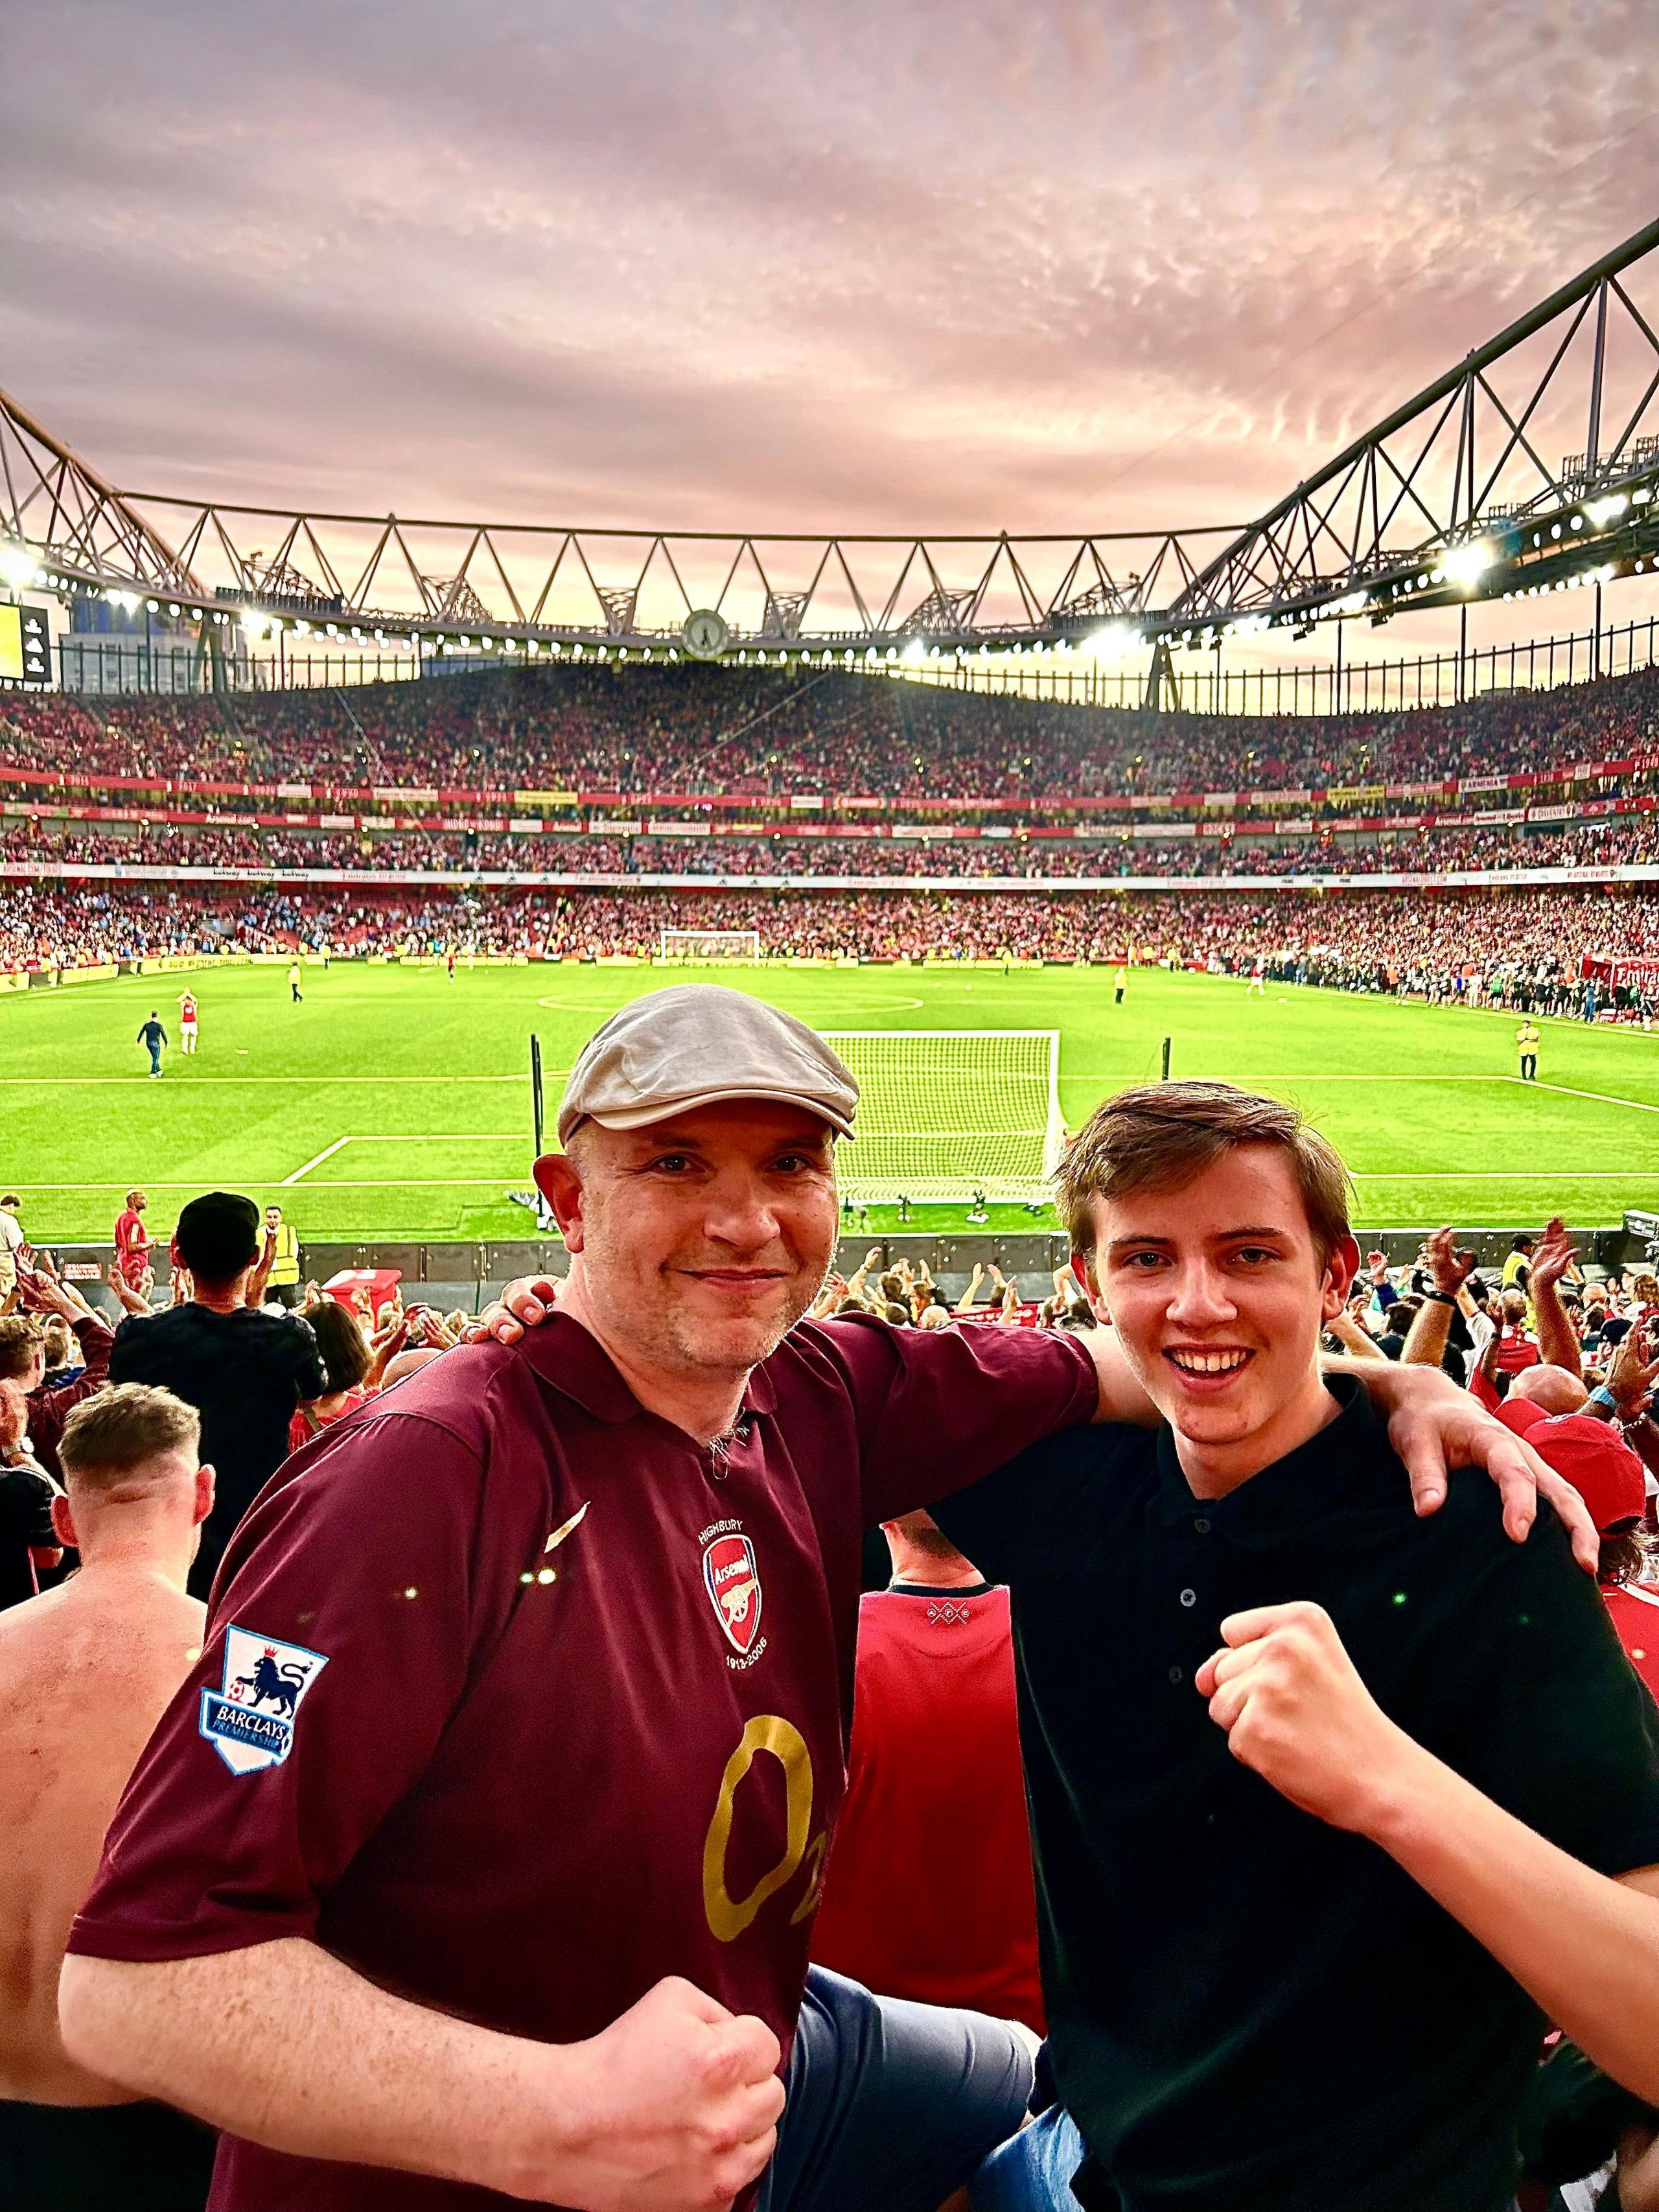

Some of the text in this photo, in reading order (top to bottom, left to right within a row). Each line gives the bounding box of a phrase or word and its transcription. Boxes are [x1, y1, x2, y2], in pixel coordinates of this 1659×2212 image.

[1468, 779, 1498, 789] ARMENIA
[698, 1519, 743, 1545] HIGHBURY
[715, 1554, 750, 1586] Arsenal
[726, 1636, 767, 1670] 1913-2006
[213, 1718, 279, 1749] PREMIERSHIP
[216, 1705, 286, 1740] BARCLAYS
